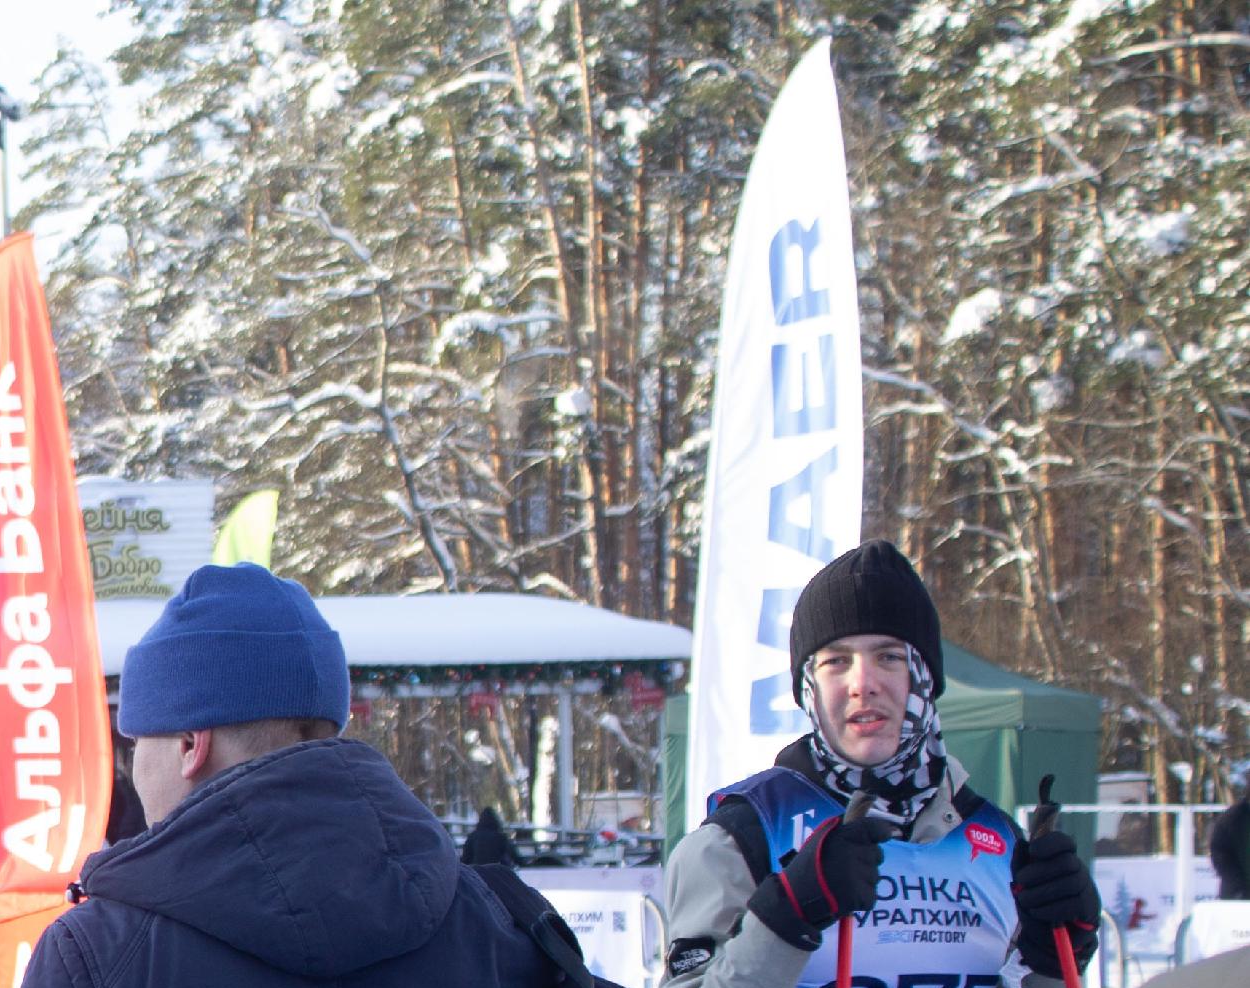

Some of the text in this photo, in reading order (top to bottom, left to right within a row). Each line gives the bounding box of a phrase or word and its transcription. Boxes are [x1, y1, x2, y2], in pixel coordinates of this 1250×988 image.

[82, 501, 171, 533] ейня
[875, 875, 976, 907] ОНКА
[854, 907, 982, 928] УРАЛХИМ
